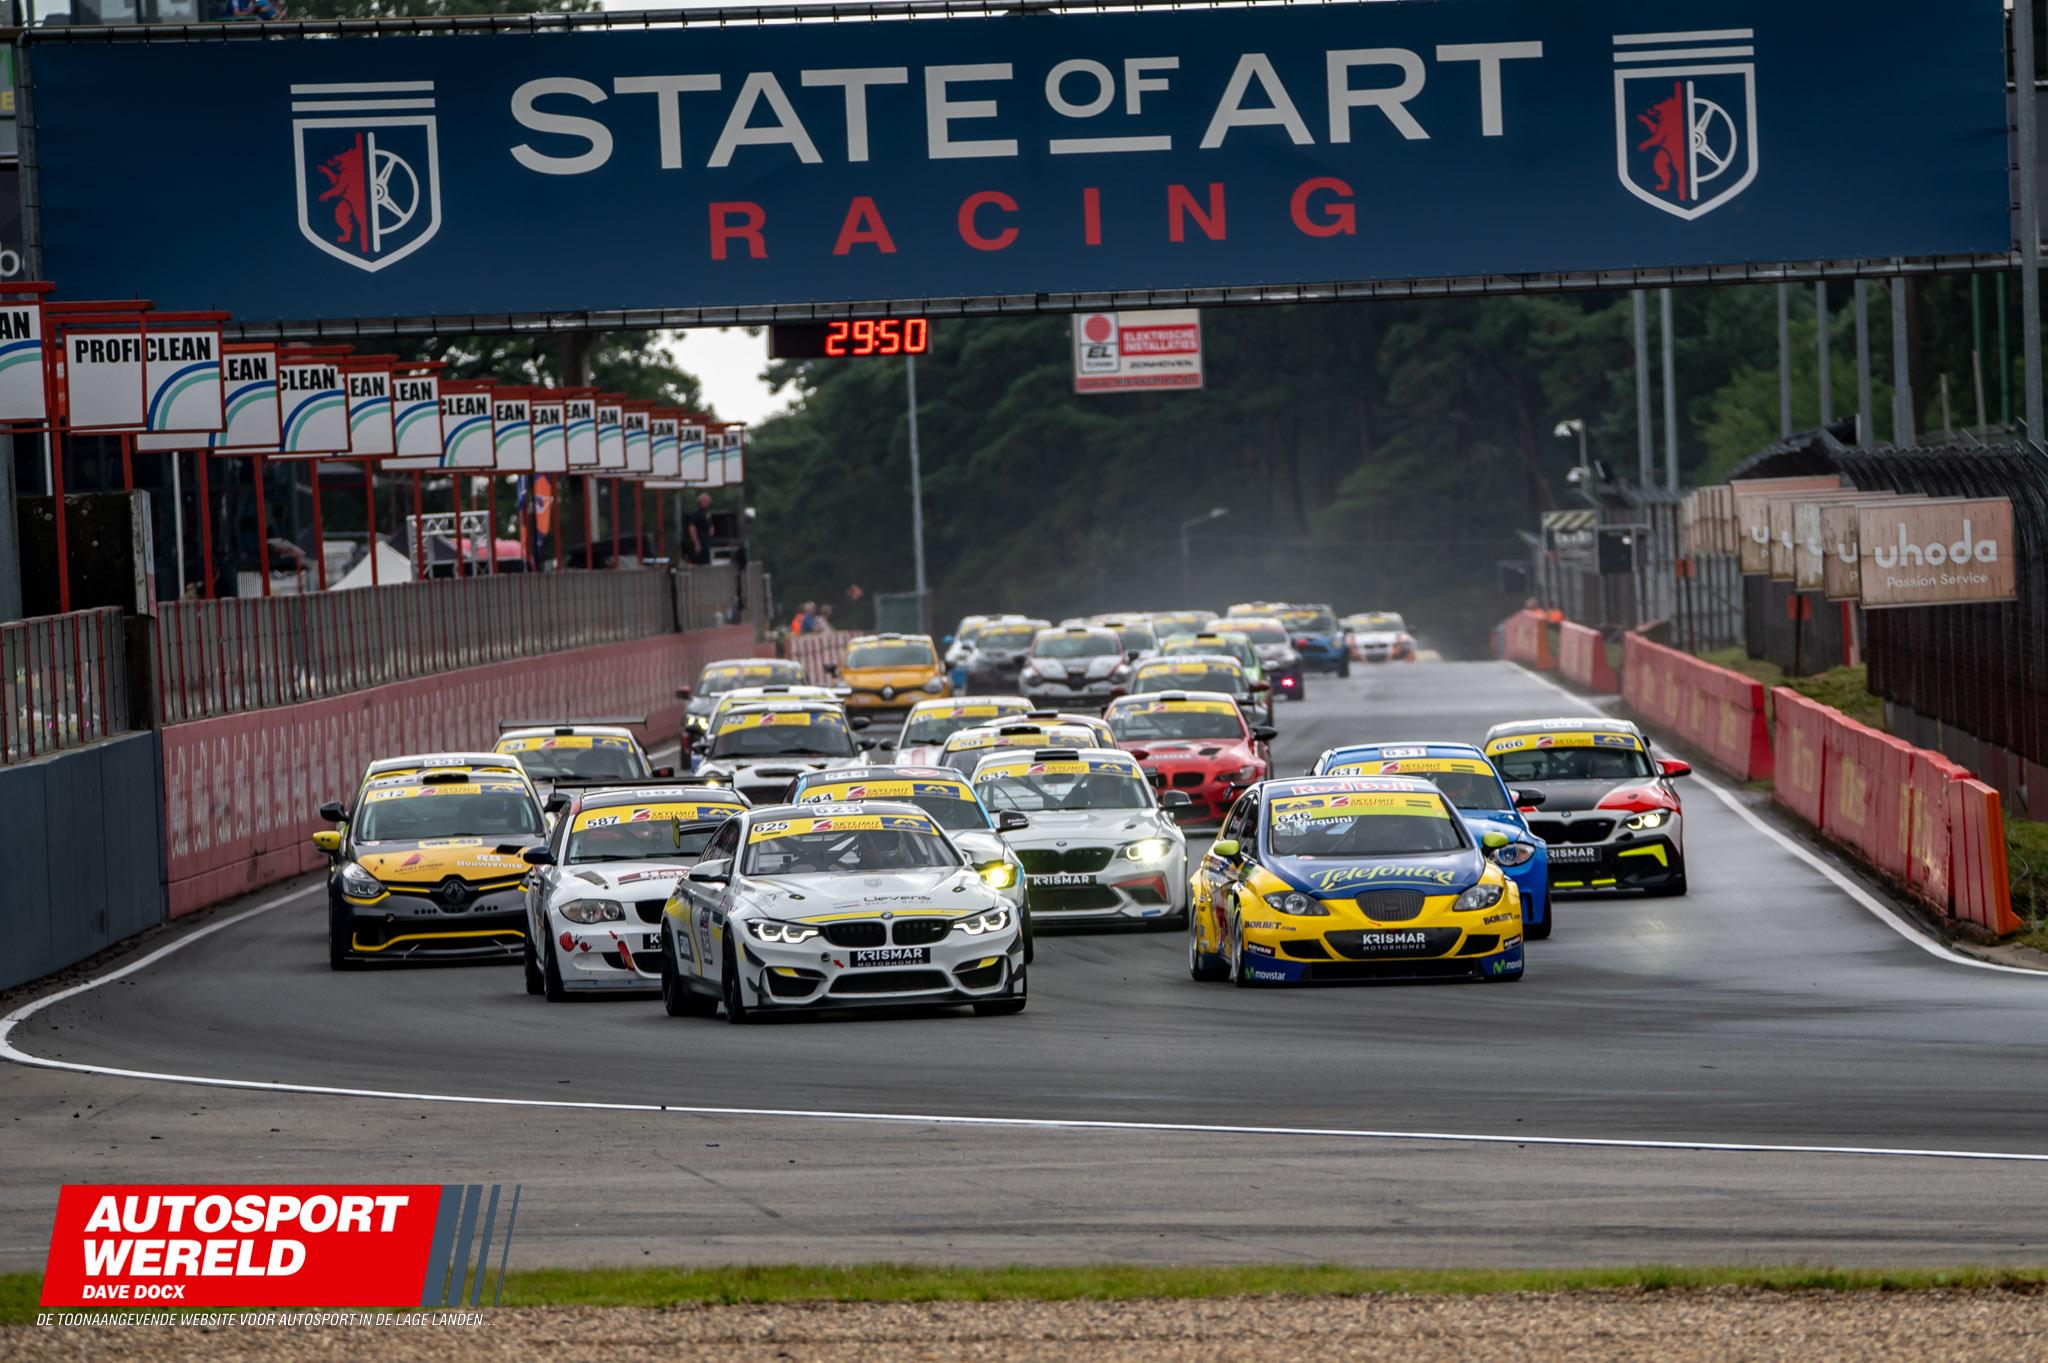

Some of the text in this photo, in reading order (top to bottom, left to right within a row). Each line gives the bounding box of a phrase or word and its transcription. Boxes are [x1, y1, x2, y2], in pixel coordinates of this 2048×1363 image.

[510, 40, 1544, 175] STATE OF ART
[708, 177, 1358, 261] RACING
[825, 318, 927, 356] 29:50
[1874, 518, 1998, 569] uhoda
[1887, 571, 1989, 589] Passion Service
[1496, 739, 1524, 751] 666
[1332, 766, 1361, 776] 631
[1294, 780, 1414, 795] Red Bull
[587, 816, 618, 828] 587
[754, 821, 789, 833] 625
[1549, 847, 1595, 858] RISMAR
[1033, 875, 1090, 886] KRISMAR
[1363, 933, 1426, 945] KRISMAR
[857, 948, 923, 962] KRISMAR
[857, 959, 924, 968] MOTORHOMES
[1255, 970, 1286, 980] movistar
